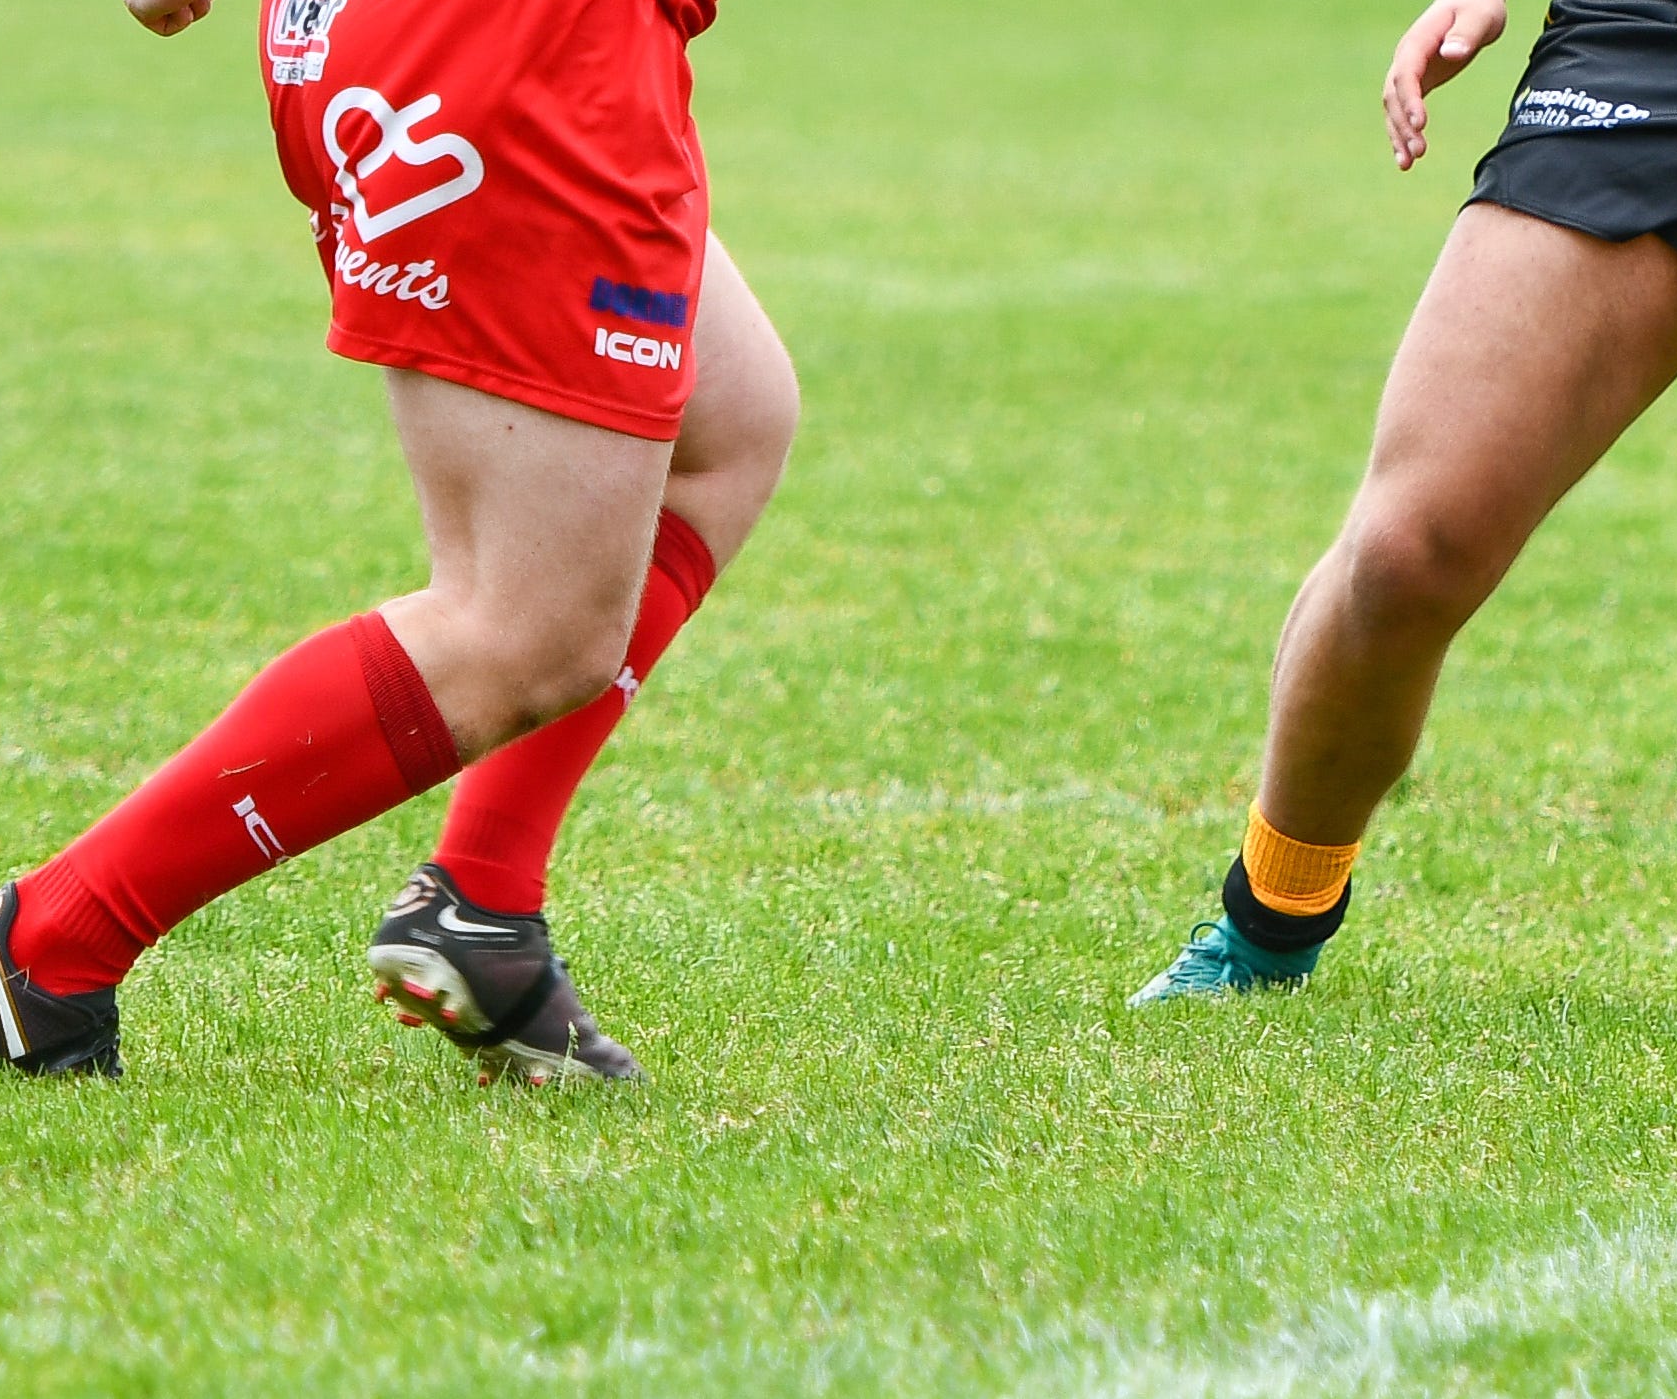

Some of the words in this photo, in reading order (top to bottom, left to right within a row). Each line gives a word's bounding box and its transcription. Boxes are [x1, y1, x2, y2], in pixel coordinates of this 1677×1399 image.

[1526, 88, 1613, 119] Inspiring
[1614, 104, 1651, 121] On
[594, 327, 682, 370] ICON
